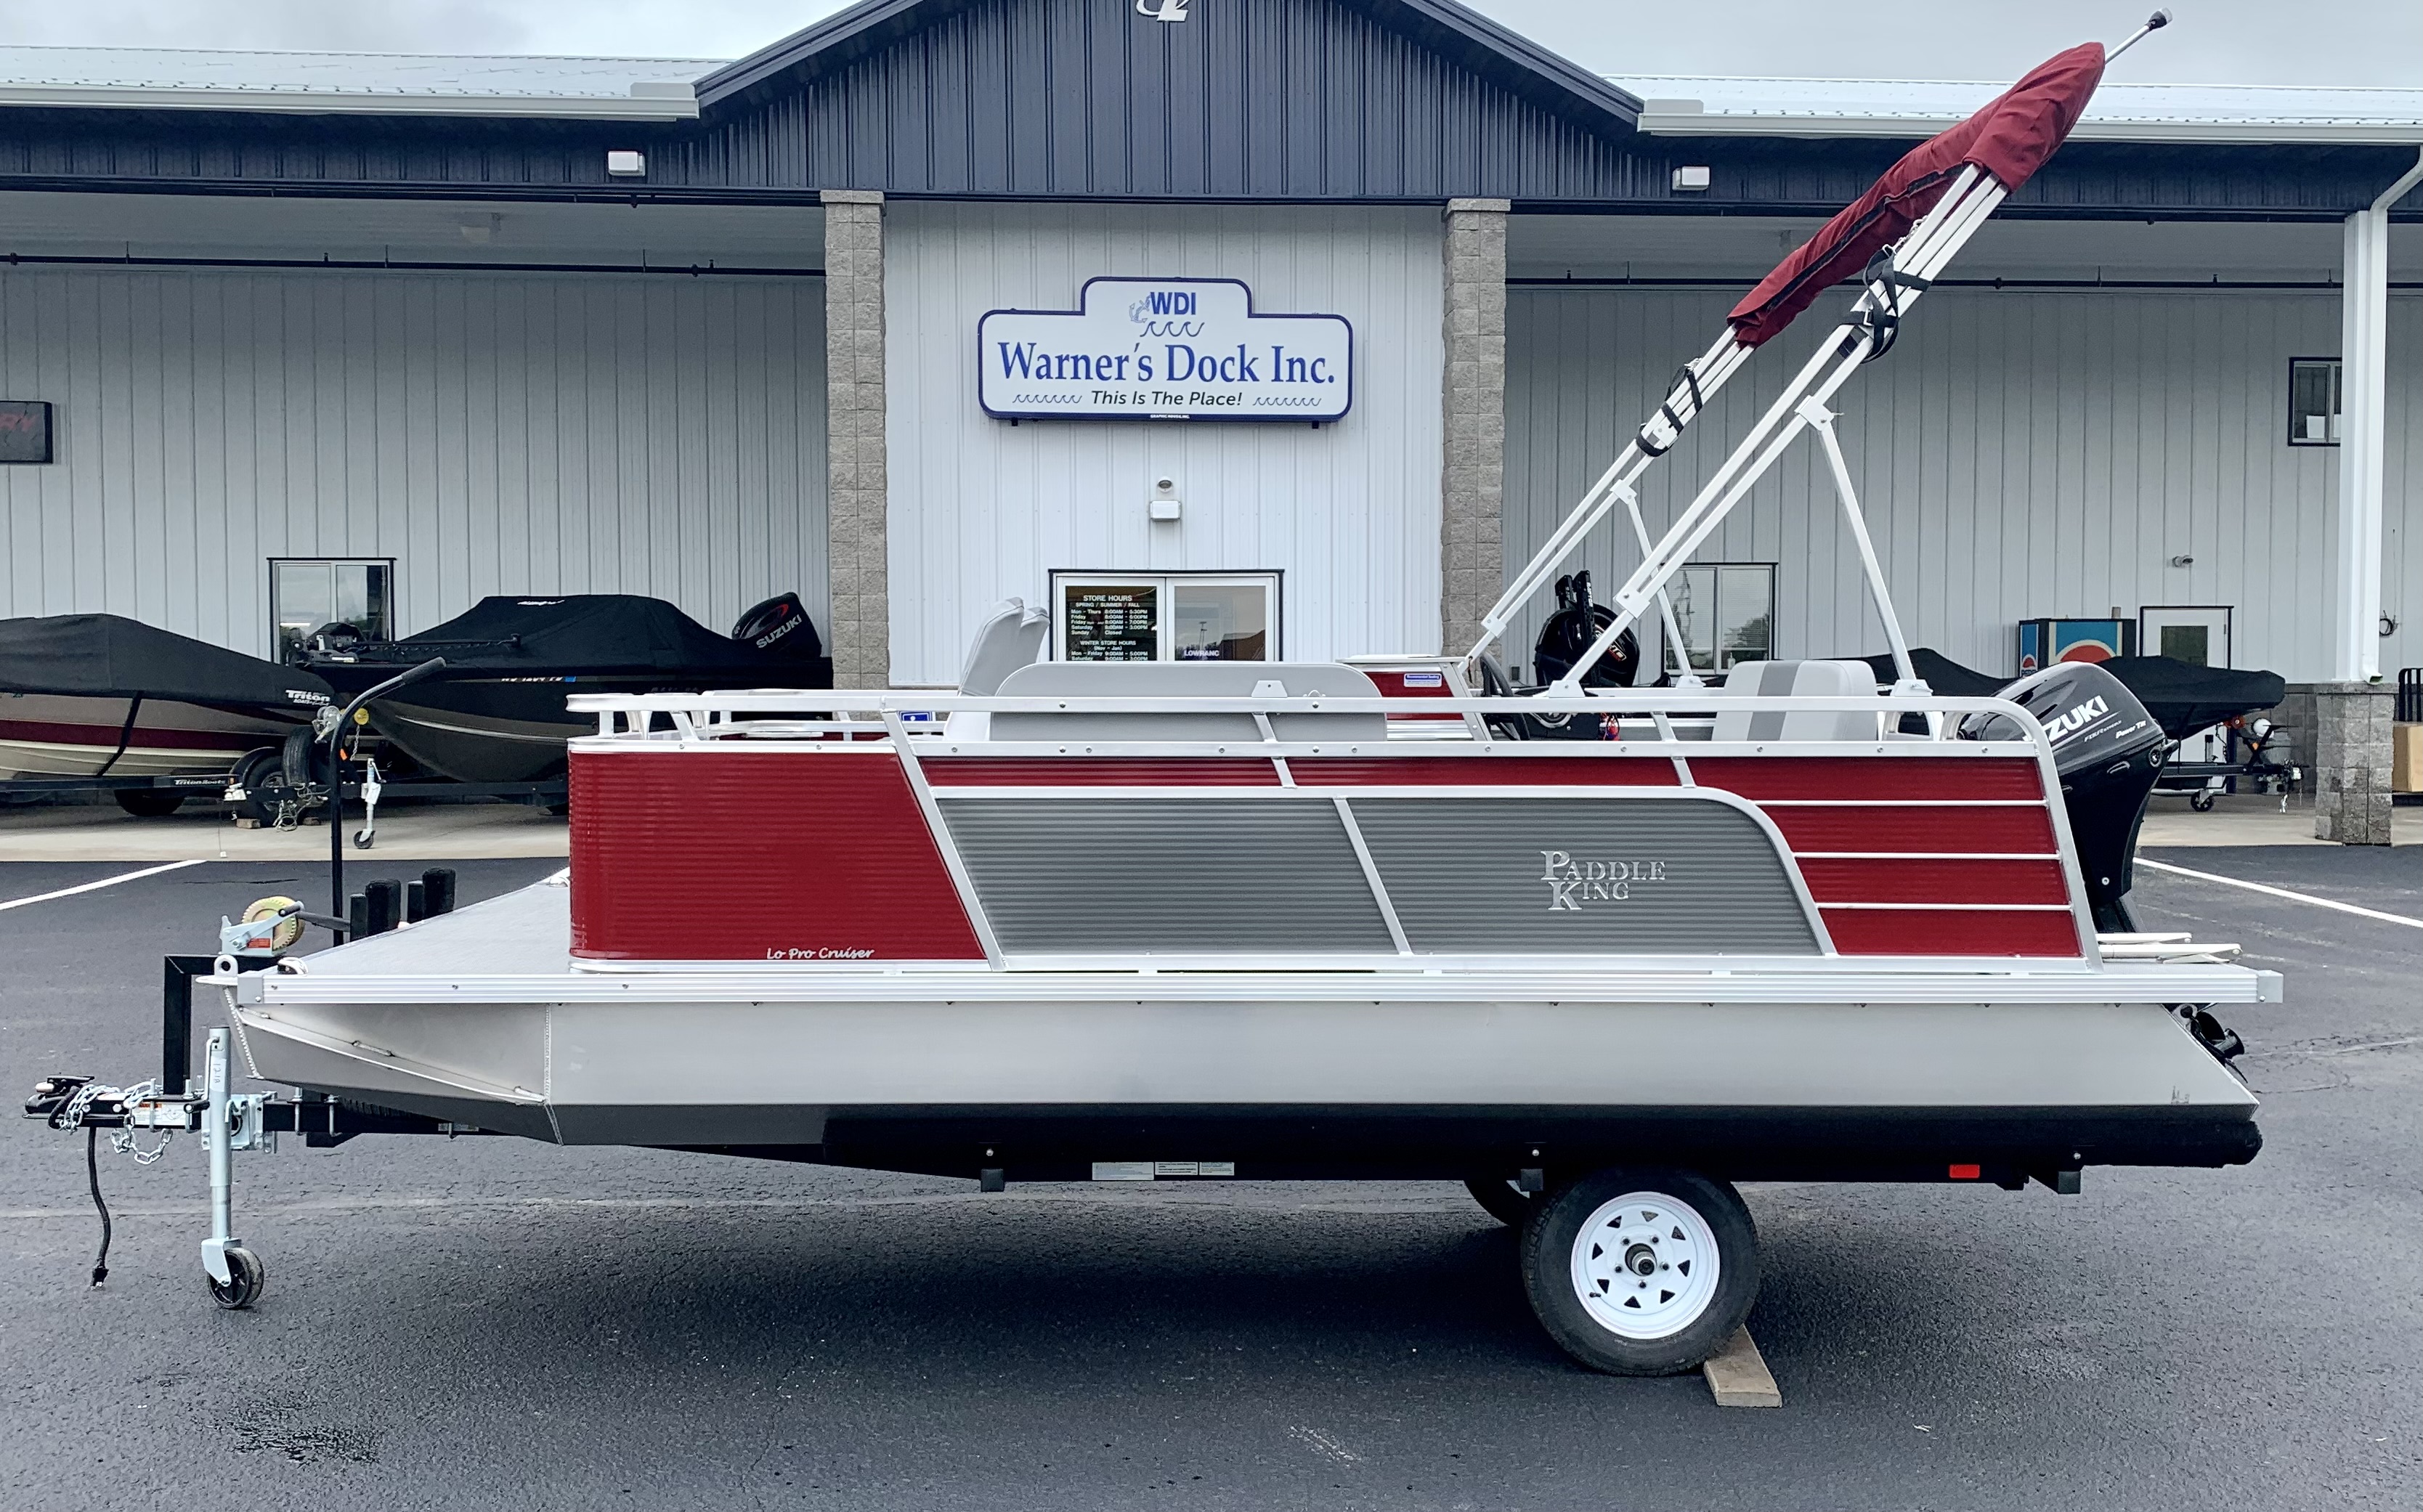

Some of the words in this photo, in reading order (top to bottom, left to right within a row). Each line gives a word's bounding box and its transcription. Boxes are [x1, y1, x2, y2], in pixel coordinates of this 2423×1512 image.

[1150, 291, 1196, 315] WDI
[997, 342, 1153, 381] Warner's
[1165, 344, 1260, 383] Dock
[1271, 346, 1335, 383] Inc.
[1091, 390, 1127, 405] This
[1132, 391, 1146, 405] Is
[1152, 391, 1183, 405] The
[1189, 392, 1243, 406] Place!
[756, 614, 802, 649] SUZUKI
[285, 689, 330, 702] Triton
[2042, 695, 2109, 741] ZUKI
[1541, 850, 1665, 880] PADDLE
[1548, 881, 1629, 910] KING
[766, 947, 786, 959] Lo
[789, 948, 816, 959] Pro
[819, 946, 874, 959] Cruiser
